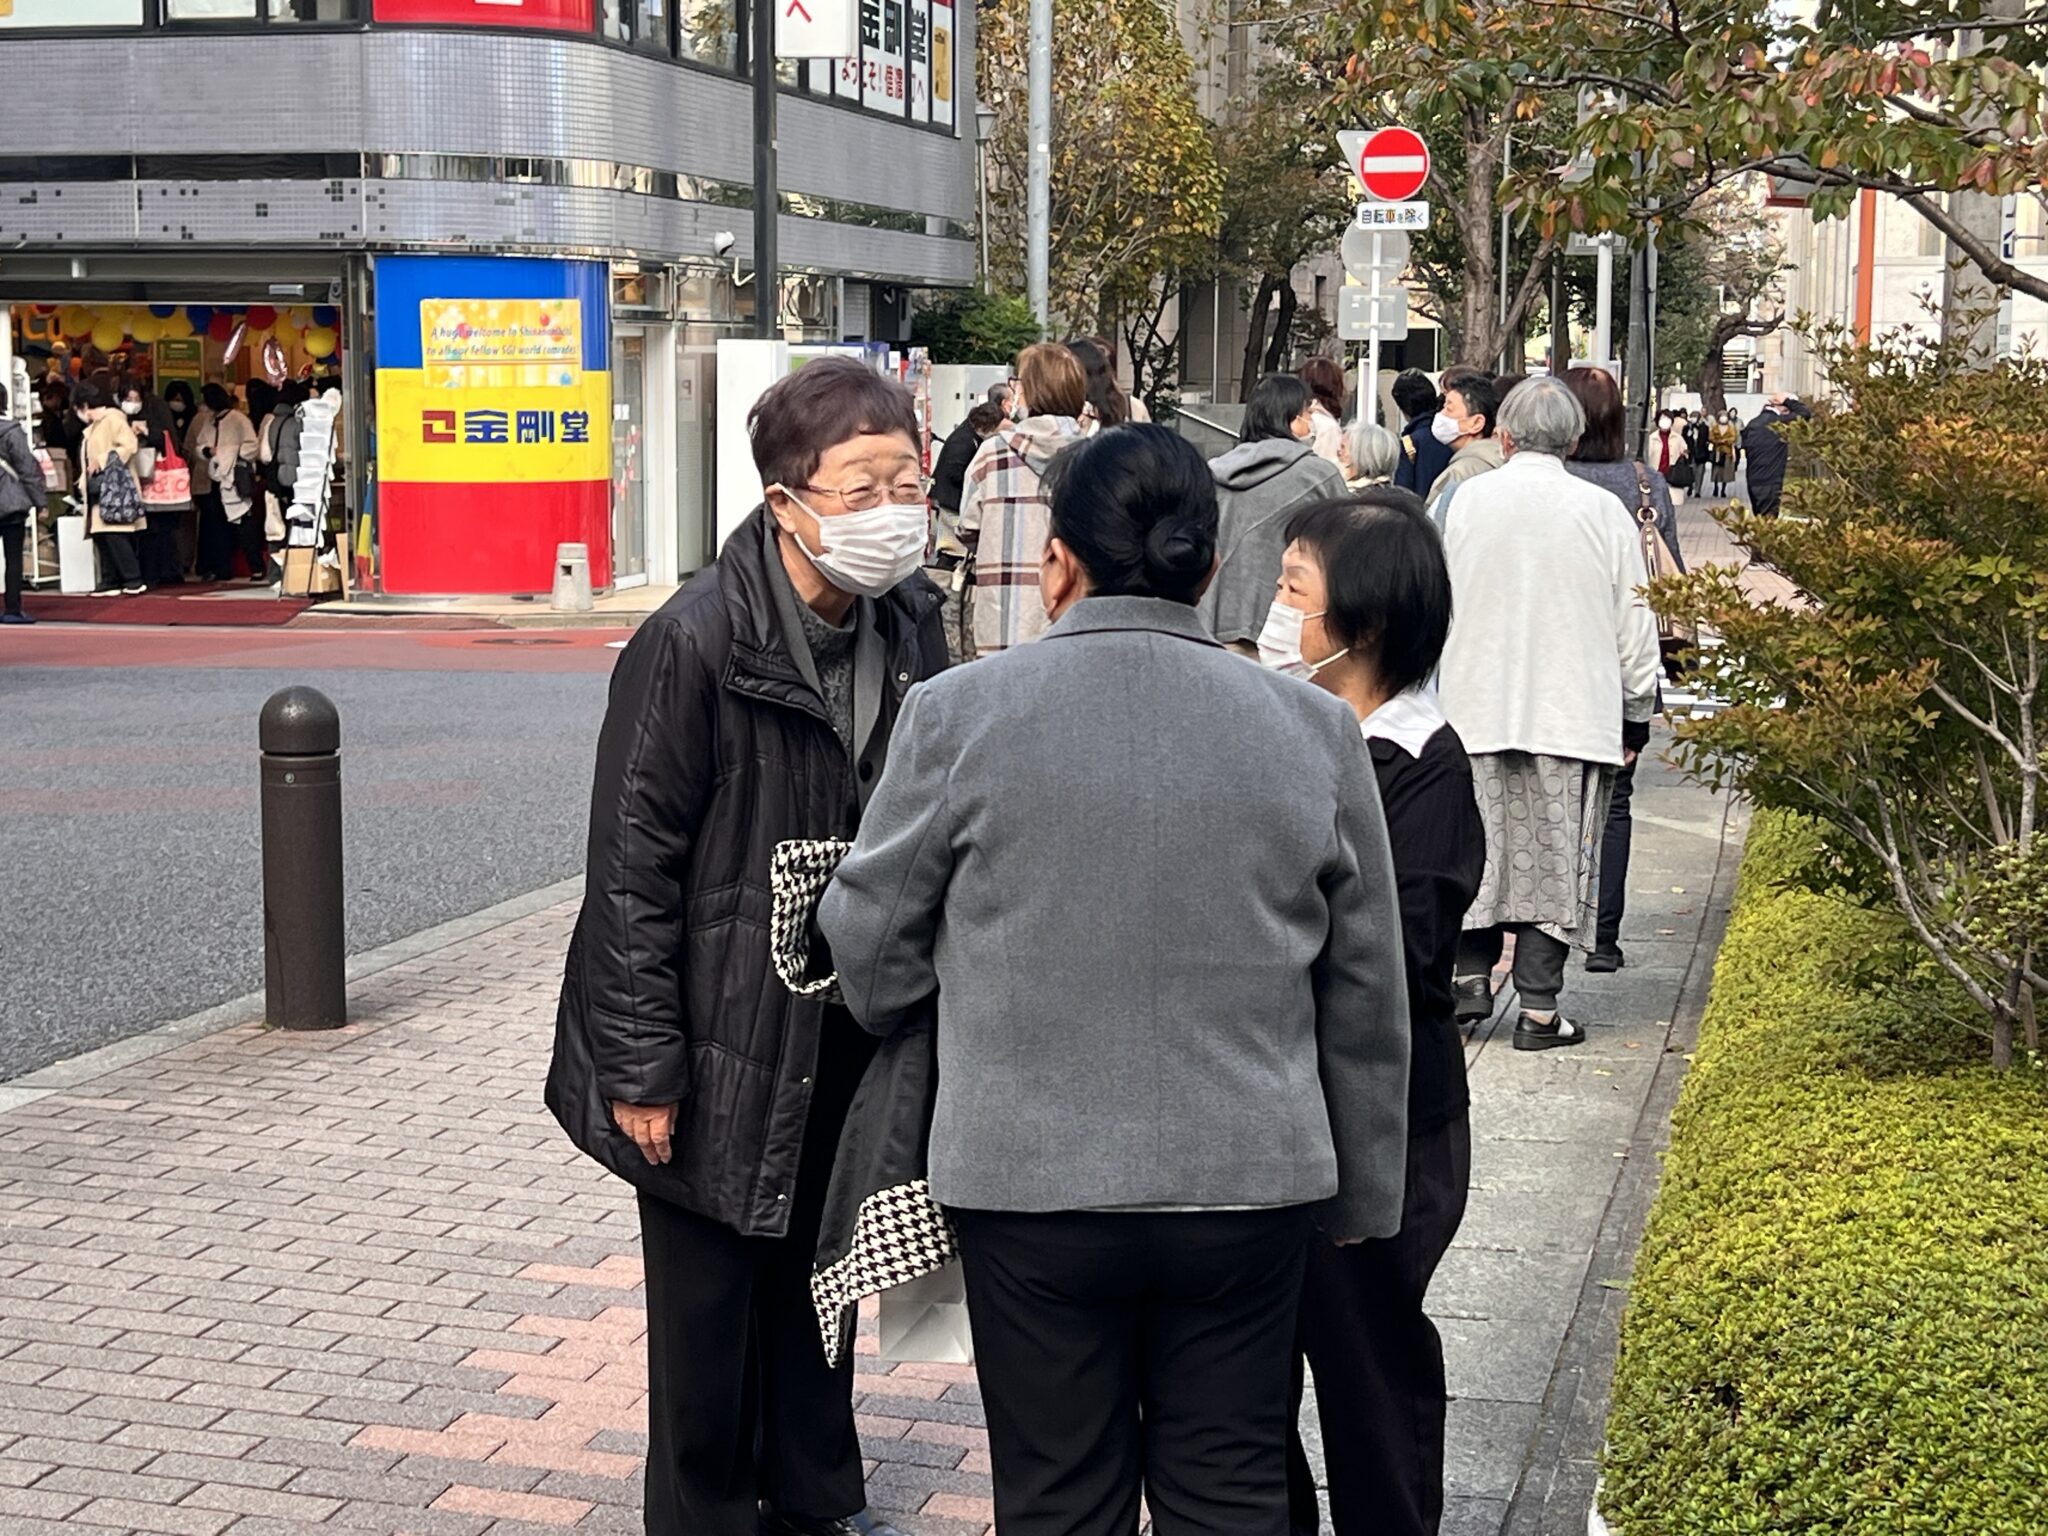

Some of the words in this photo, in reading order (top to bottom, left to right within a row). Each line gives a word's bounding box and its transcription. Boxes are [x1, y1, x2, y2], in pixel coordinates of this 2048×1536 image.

[1361, 208, 1424, 224] 自転車を除く
[431, 327, 438, 337] A
[465, 327, 505, 337] welcome
[508, 327, 517, 337] to
[427, 346, 436, 356] to
[470, 344, 499, 355] fellow
[502, 345, 516, 355] SGI
[518, 344, 541, 355] world
[464, 409, 589, 443] 金剛堂
